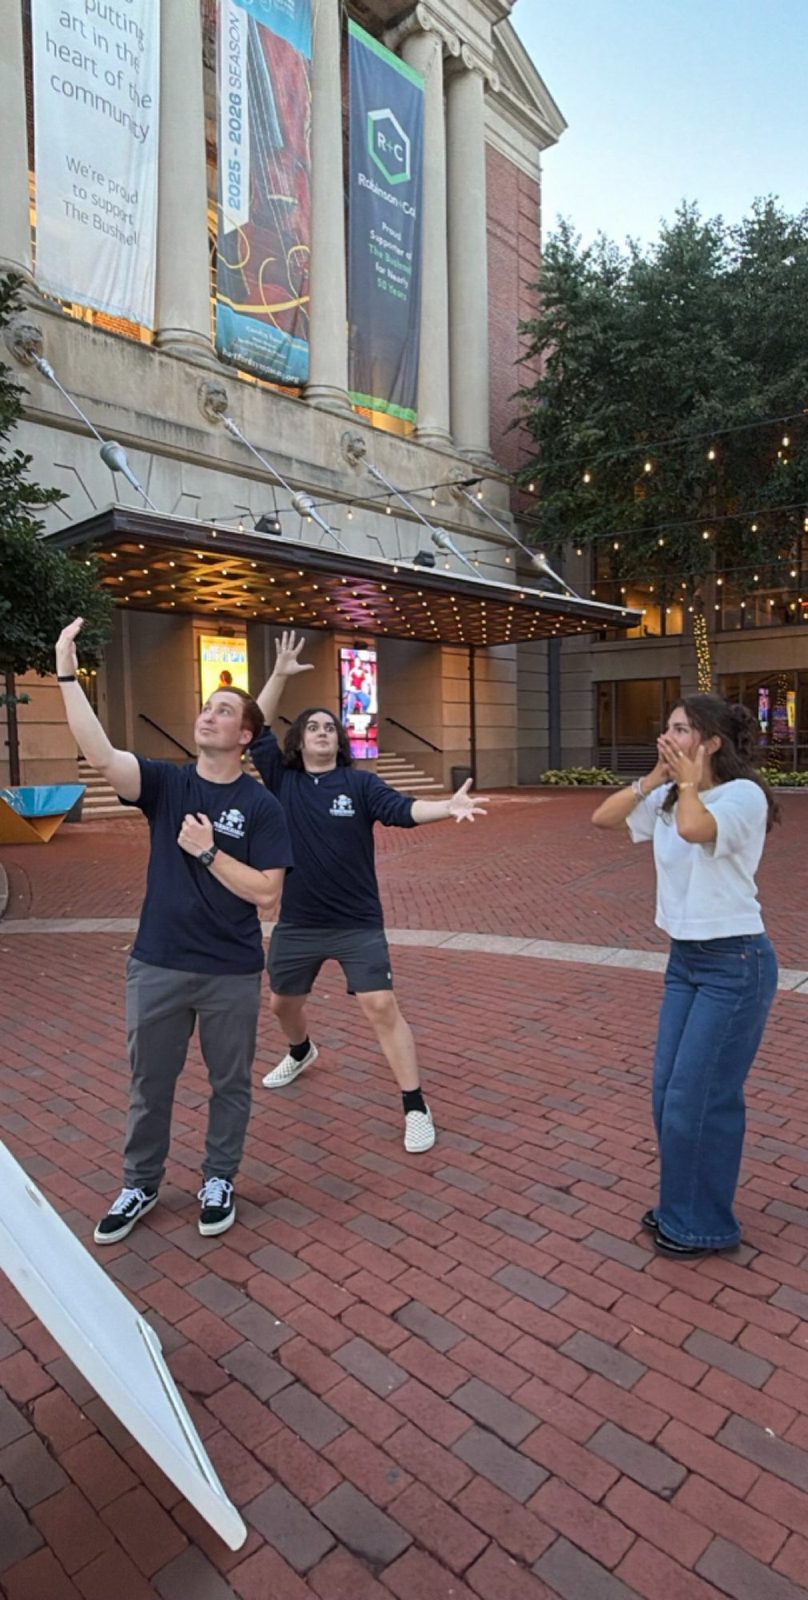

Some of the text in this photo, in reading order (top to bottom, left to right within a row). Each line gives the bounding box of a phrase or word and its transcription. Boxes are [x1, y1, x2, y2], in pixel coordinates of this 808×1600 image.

[59, 10, 87, 39] art
[92, 26, 109, 53] in
[228, 12, 242, 90] SEASON
[45, 31, 152, 108] heart of the
[50, 74, 150, 144] communty
[228, 93, 242, 145] 2026
[377, 131, 404, 163] R+C
[65, 154, 139, 204] We're proud
[228, 159, 241, 211] 2025
[62, 199, 138, 246] The Bushnel
[72, 184, 134, 226] to support
[368, 243, 383, 259] The
[375, 261, 386, 275] for
